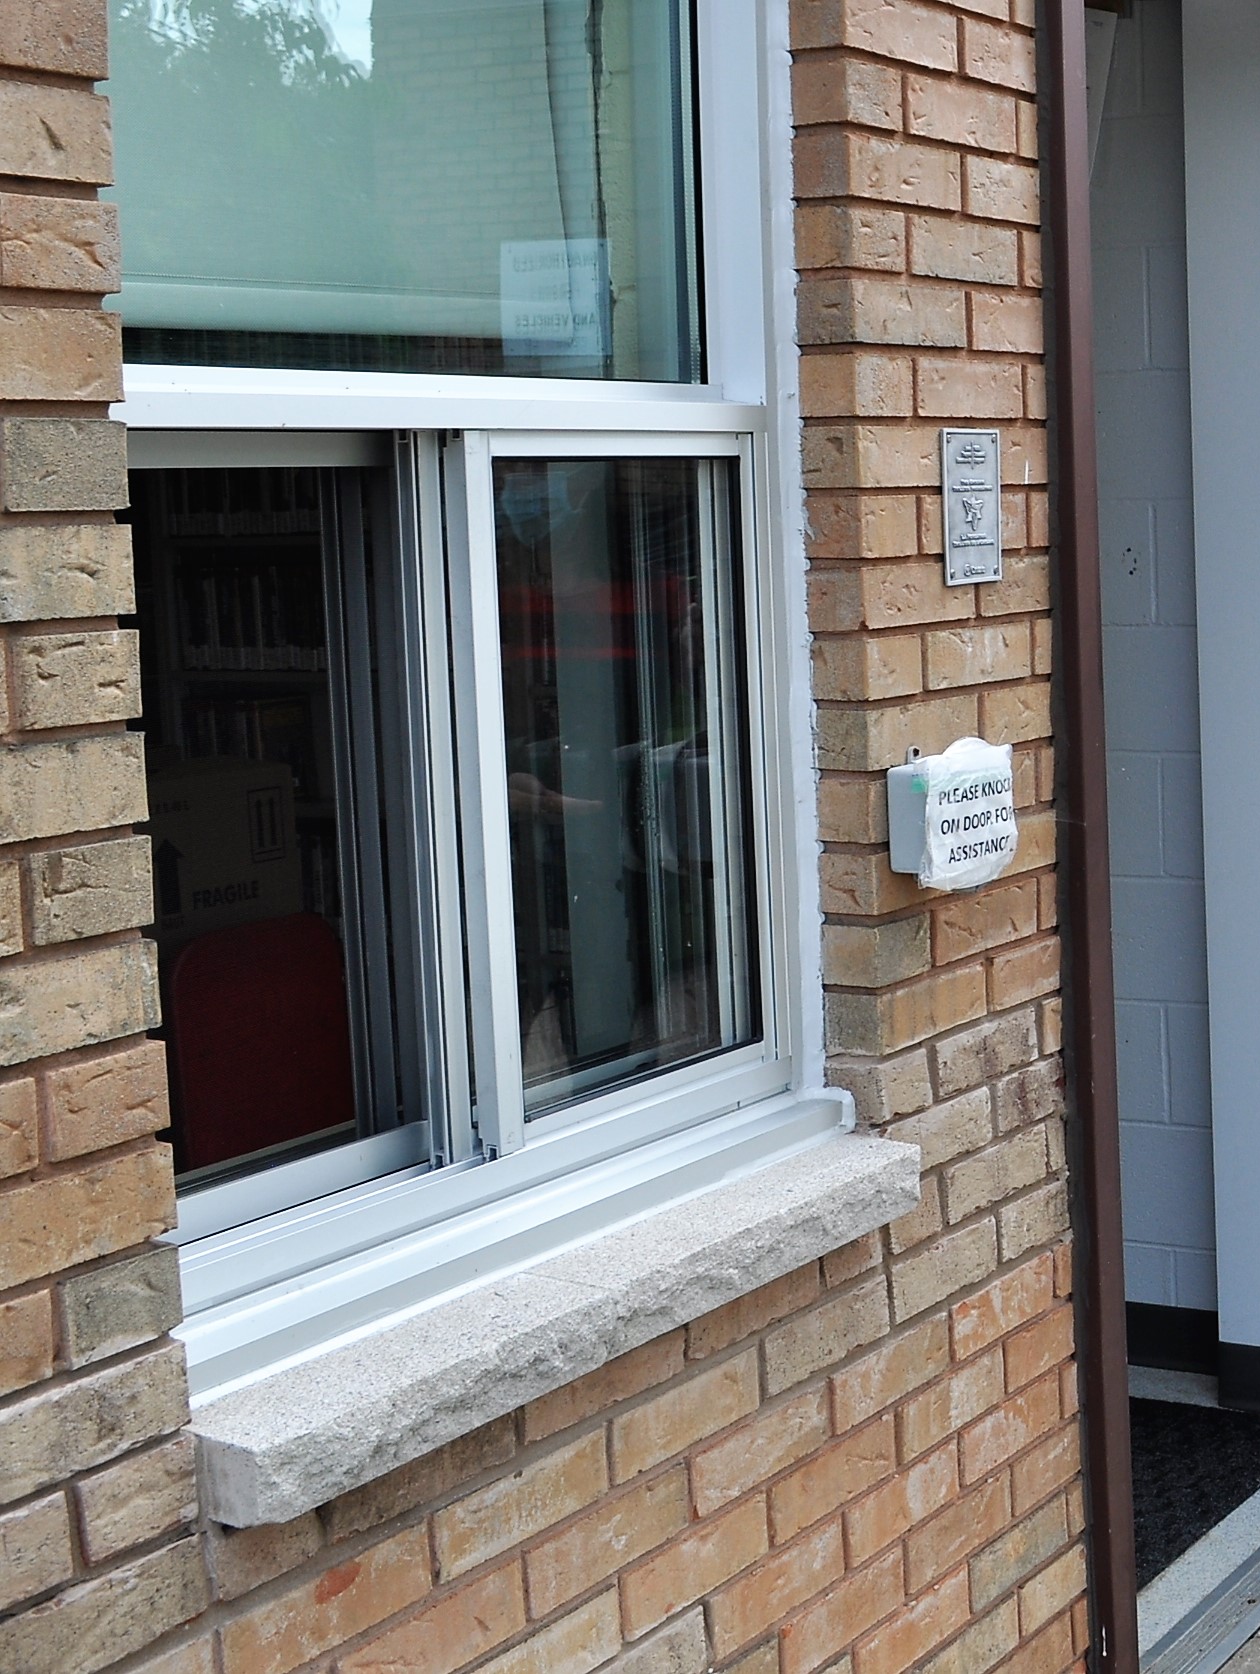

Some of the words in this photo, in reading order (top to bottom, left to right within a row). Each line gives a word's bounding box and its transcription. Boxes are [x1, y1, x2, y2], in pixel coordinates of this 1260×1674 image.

[939, 784, 979, 806] PLEASE
[941, 818, 960, 835] ON
[963, 810, 993, 831] DOOR
[193, 880, 259, 910] FRAGILE
